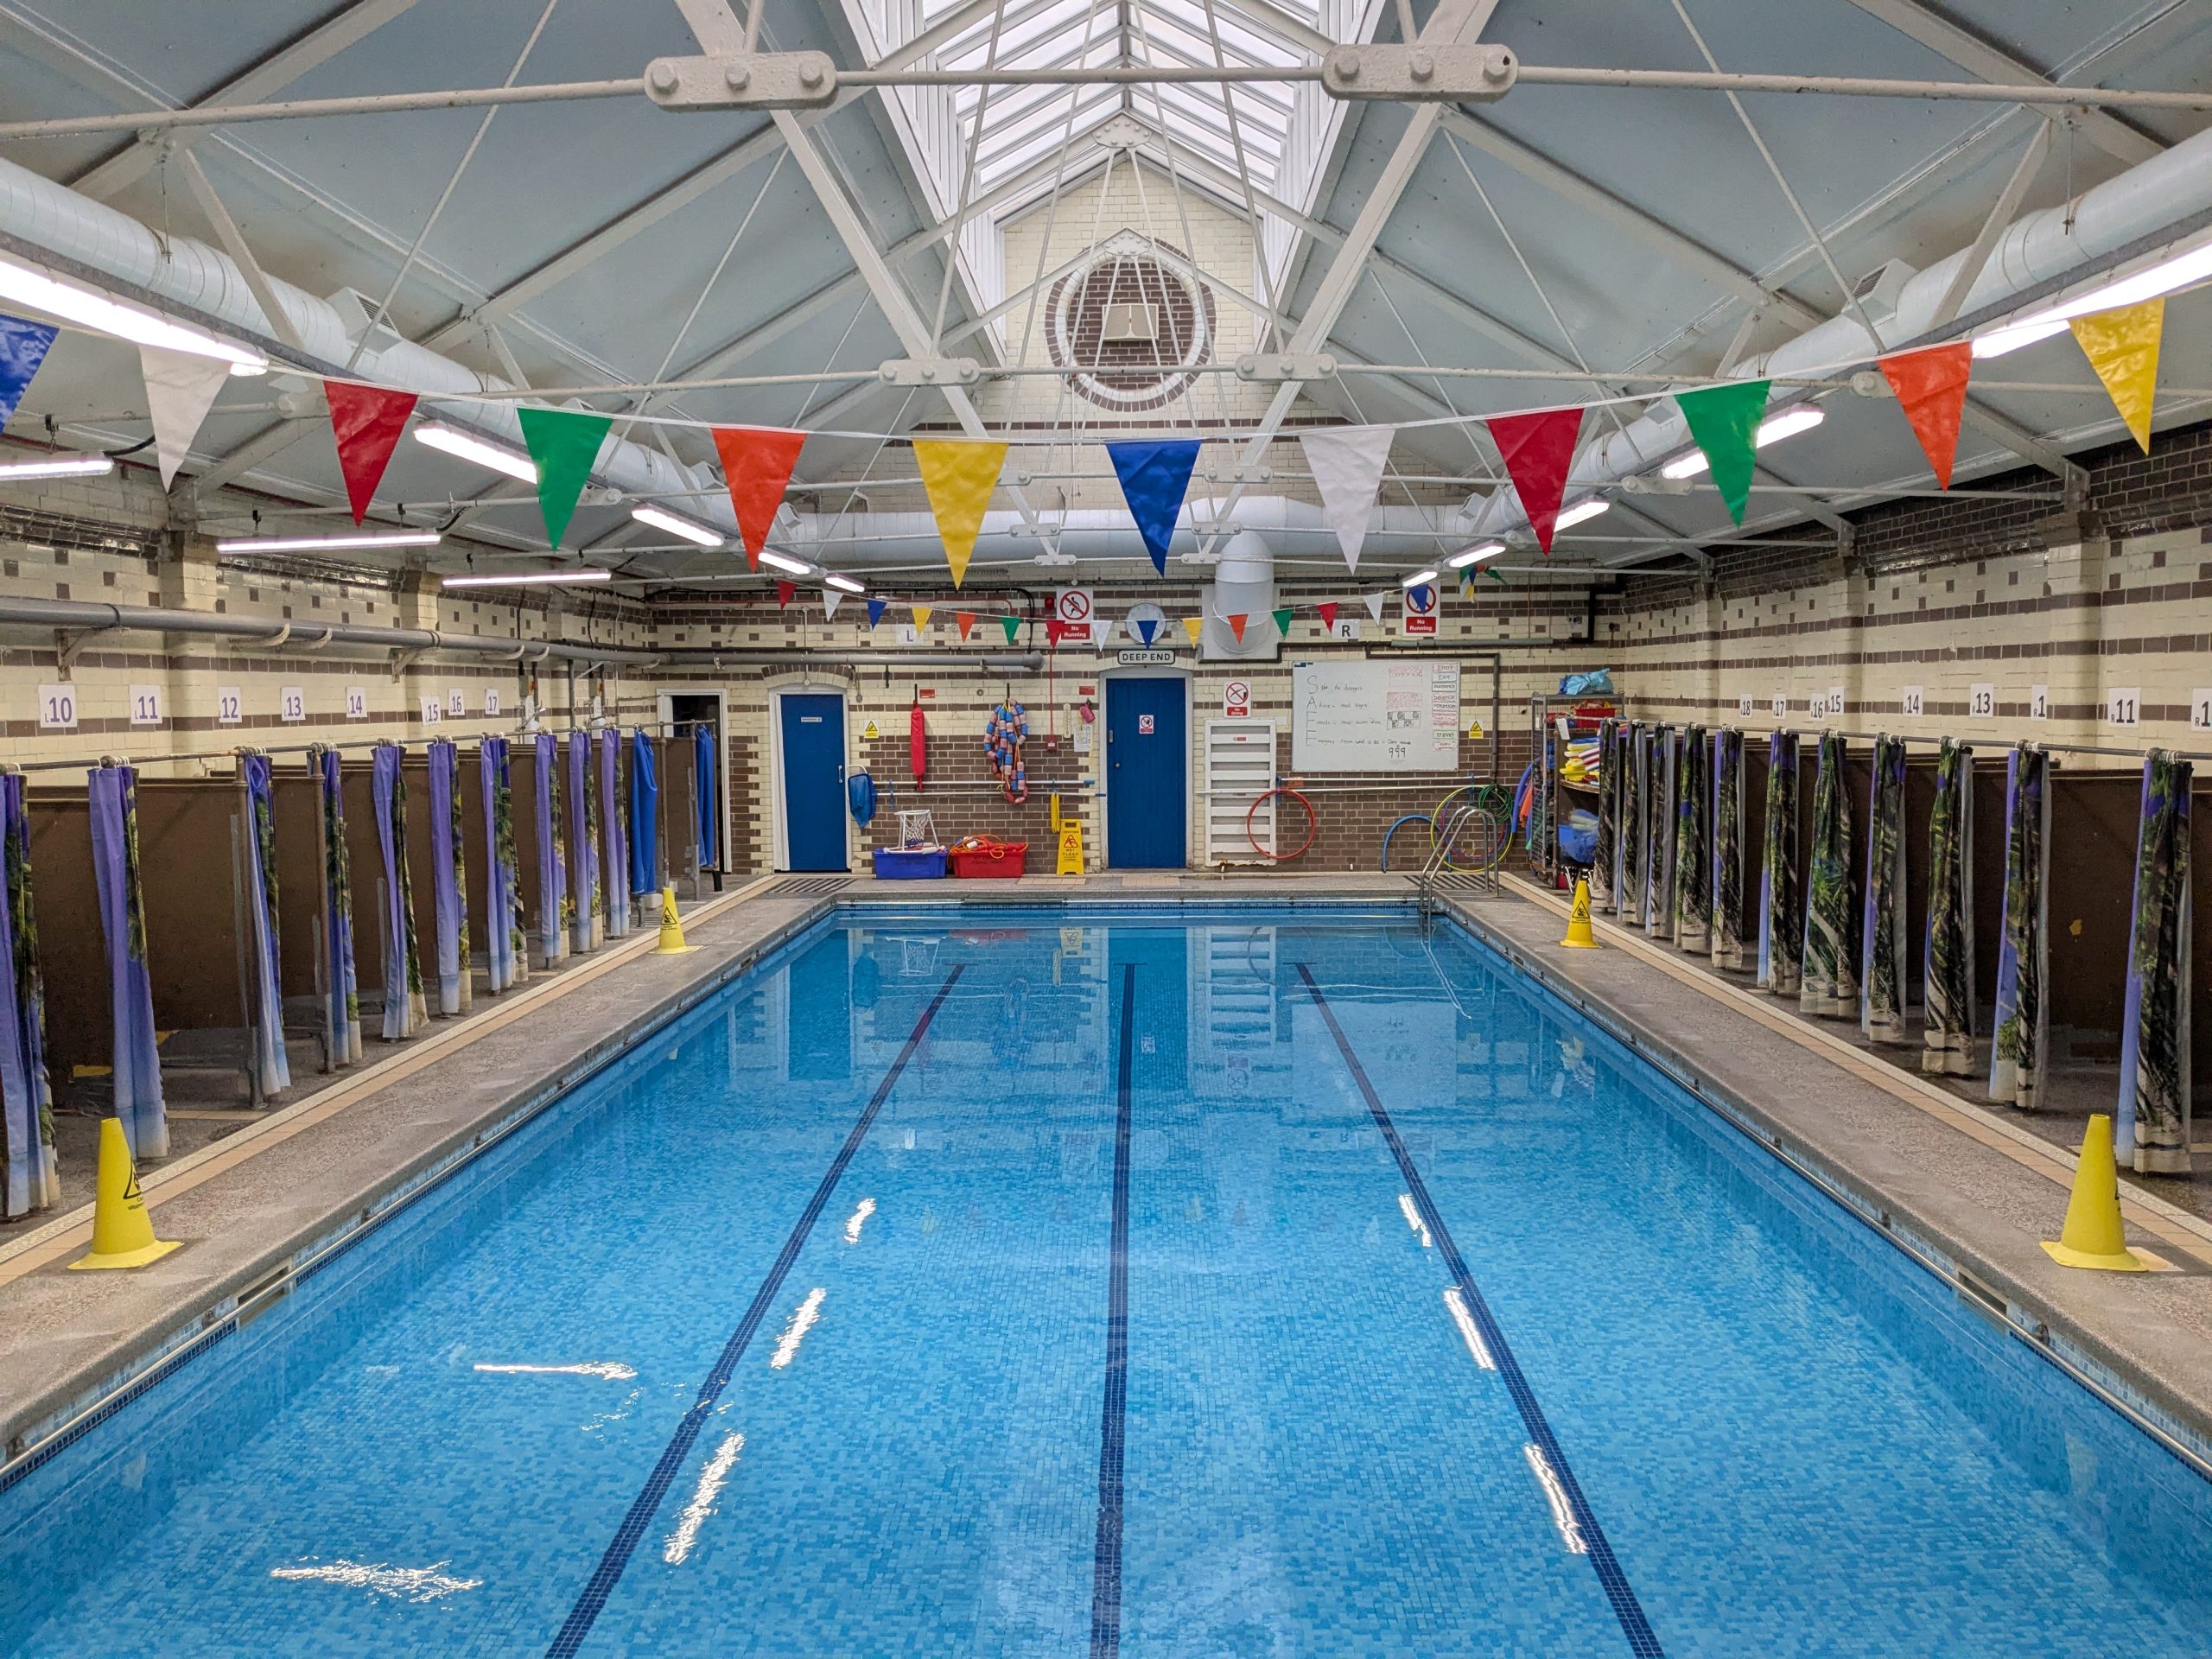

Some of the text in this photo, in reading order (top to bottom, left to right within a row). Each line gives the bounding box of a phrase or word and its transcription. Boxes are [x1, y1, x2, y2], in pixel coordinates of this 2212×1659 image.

[906, 630, 913, 642] L
[1341, 625, 1351, 637] R
[2033, 696, 2046, 718] R1
[2195, 701, 2212, 727] R1
[1389, 747, 1406, 758] 999
